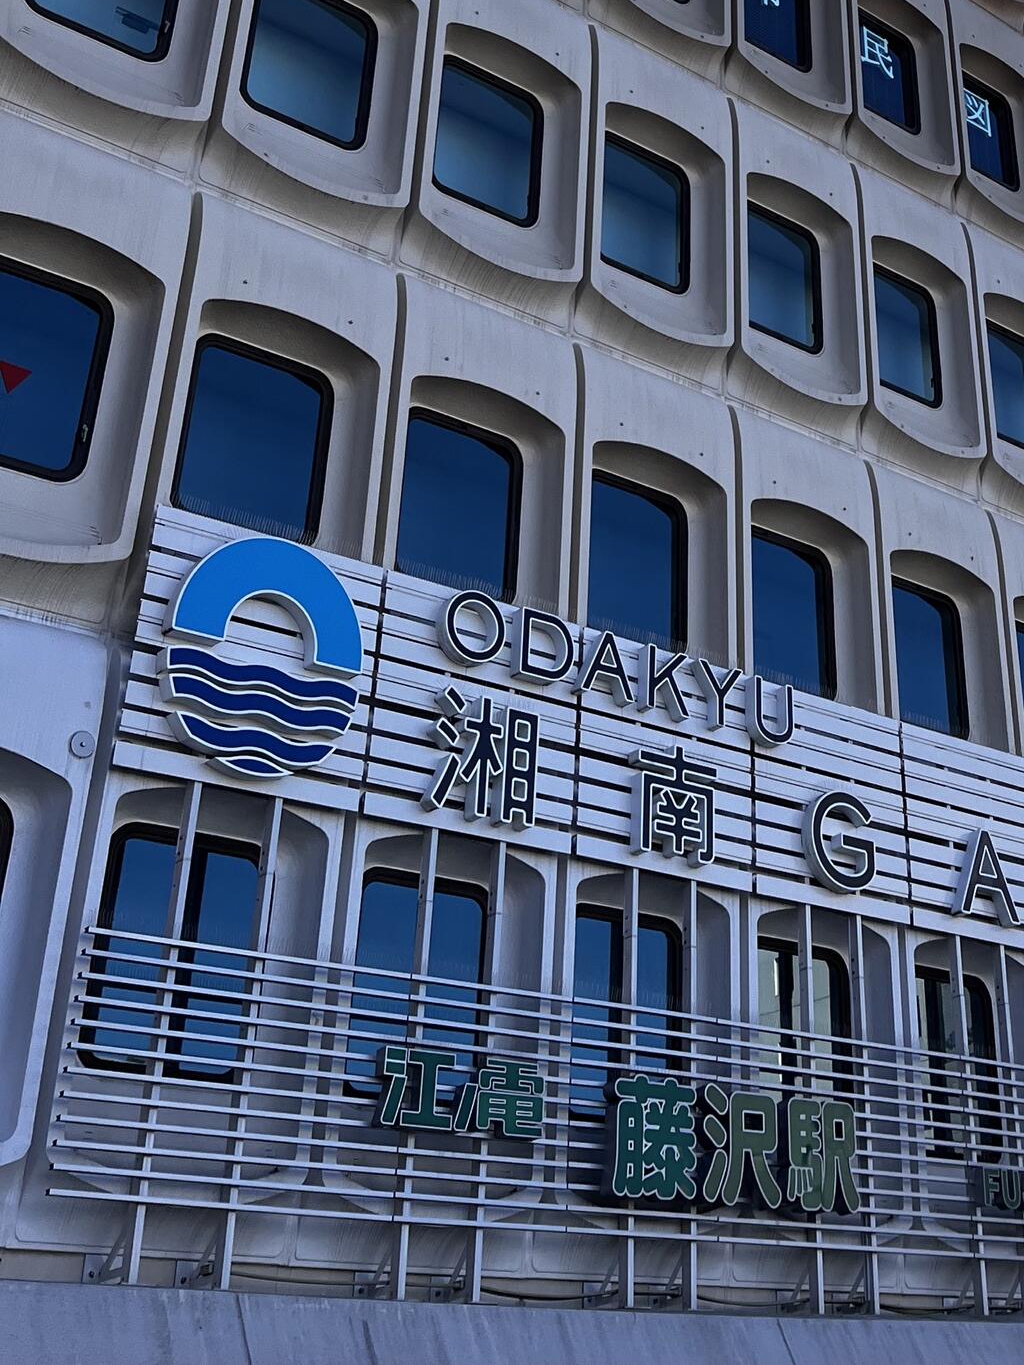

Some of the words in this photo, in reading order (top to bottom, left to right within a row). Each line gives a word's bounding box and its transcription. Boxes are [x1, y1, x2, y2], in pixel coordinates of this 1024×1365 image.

[440, 589, 796, 746] ODAKYU
[428, 685, 718, 866] 湘南
[612, 1074, 862, 1214] 藤沢駅
